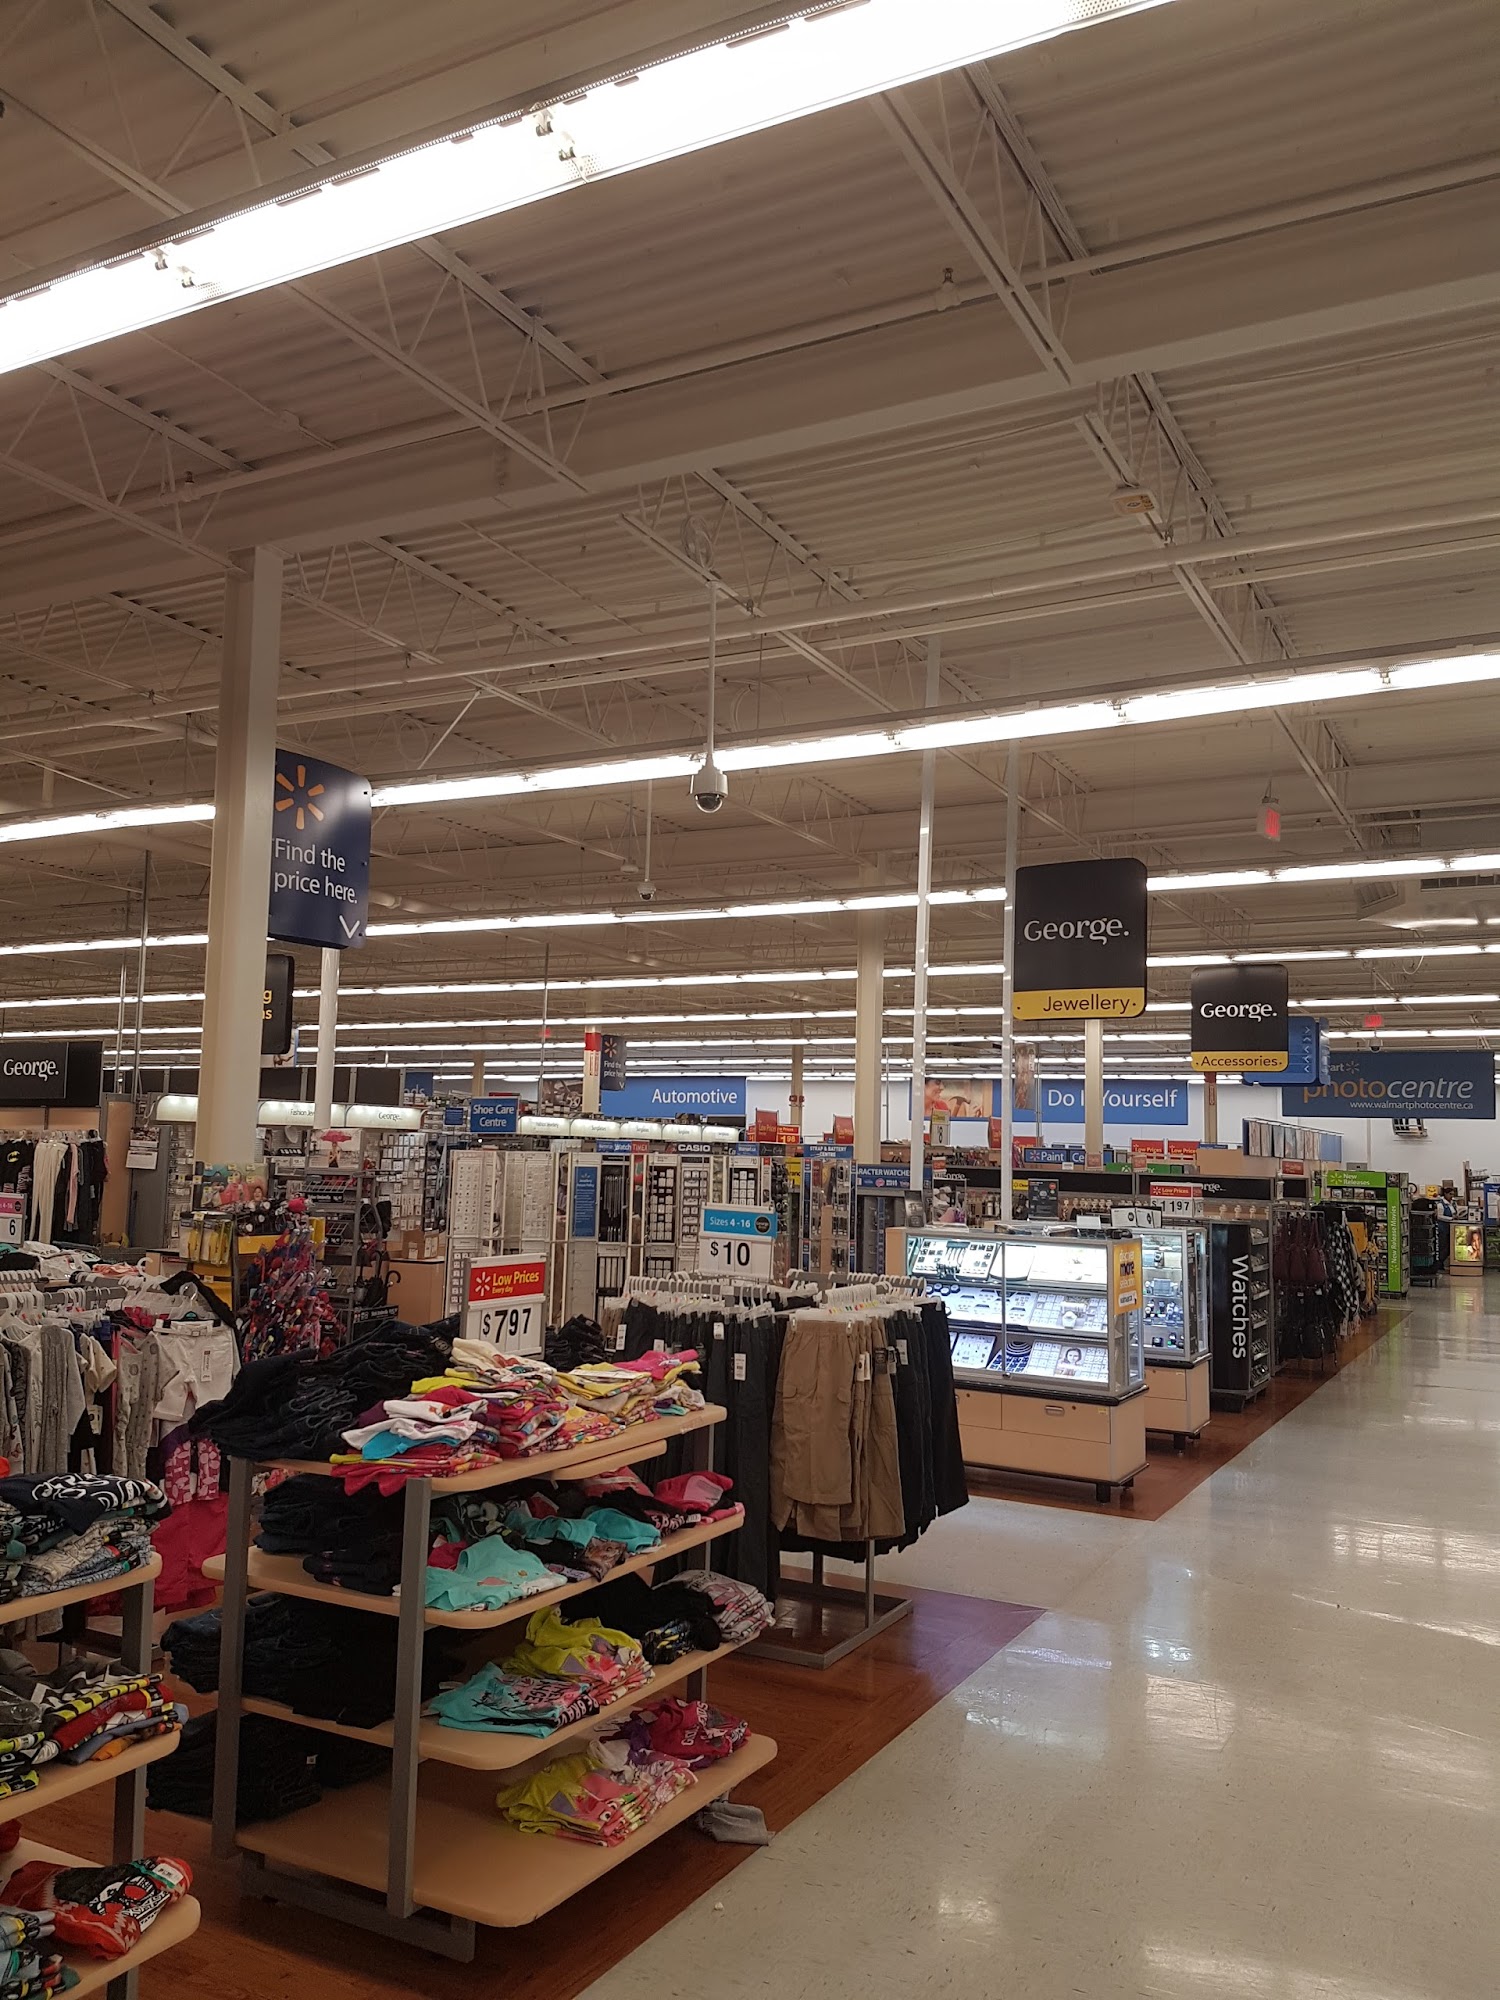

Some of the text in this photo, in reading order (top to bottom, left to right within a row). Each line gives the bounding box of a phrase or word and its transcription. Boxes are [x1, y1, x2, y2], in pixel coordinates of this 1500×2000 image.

[274, 838, 346, 872] Find the
[274, 871, 358, 904] price here.
[1023, 917, 1130, 945] George.
[1043, 994, 1130, 1015] Jewellery
[1200, 1002, 1277, 1023] George.
[1201, 1055, 1277, 1067] Accessories
[3, 1058, 60, 1081] George.
[652, 1088, 737, 1104] Automotive
[1048, 1090, 1075, 1107] Do
[473, 1104, 515, 1114] Shoe Care
[1350, 1101, 1474, 1110] www.walmartphotocentre.ca
[480, 1118, 507, 1127] Centre
[678, 1144, 711, 1152] CASIO
[1041, 1151, 1065, 1162] Paint
[885, 1168, 910, 1177] WATCHE
[709, 1217, 729, 1226] Sizes
[492, 1270, 540, 1286] Low Prices
[1231, 1254, 1250, 1359] Watches
